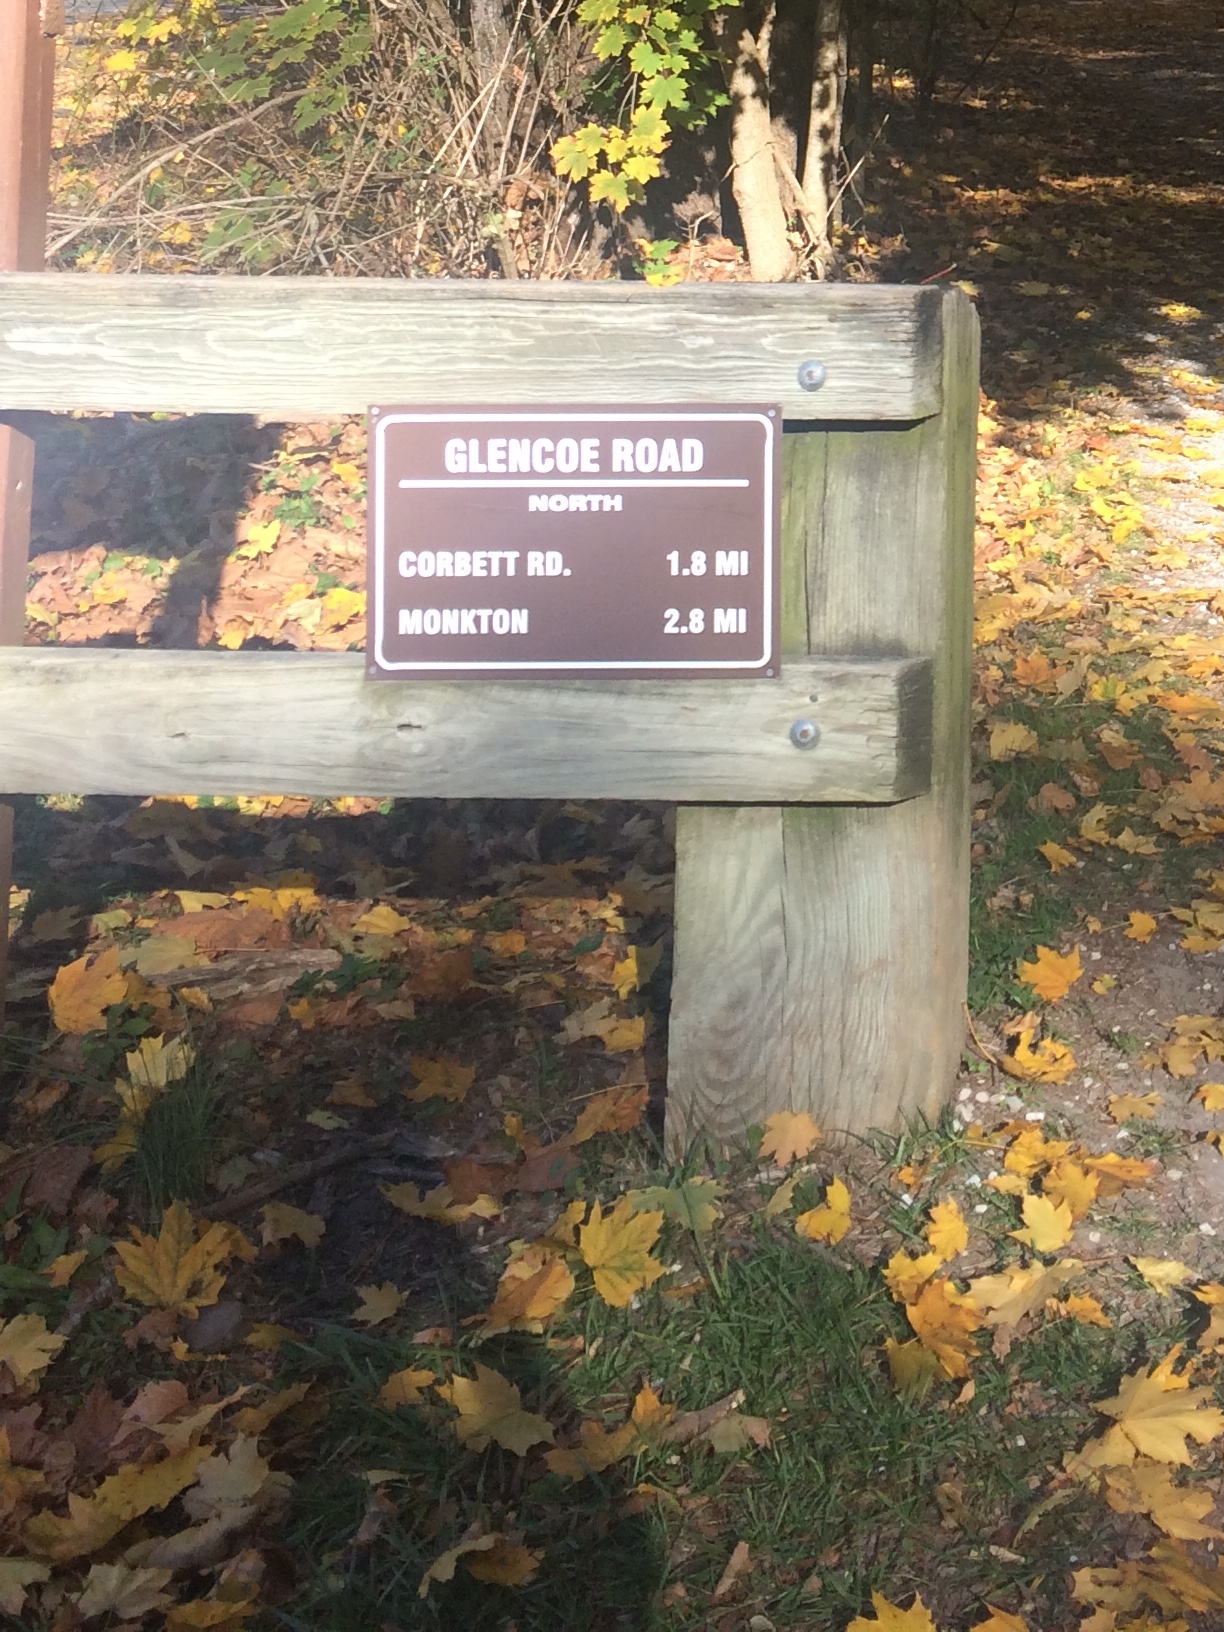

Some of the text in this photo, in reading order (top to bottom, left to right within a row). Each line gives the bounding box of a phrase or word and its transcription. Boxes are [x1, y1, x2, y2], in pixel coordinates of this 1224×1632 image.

[445, 437, 703, 473] GLENCOE ROAD
[529, 494, 622, 511] NORTH
[399, 551, 748, 577] CORBETT RD. 1.8 MI
[399, 608, 746, 634] MONKTON 2.8 MI
